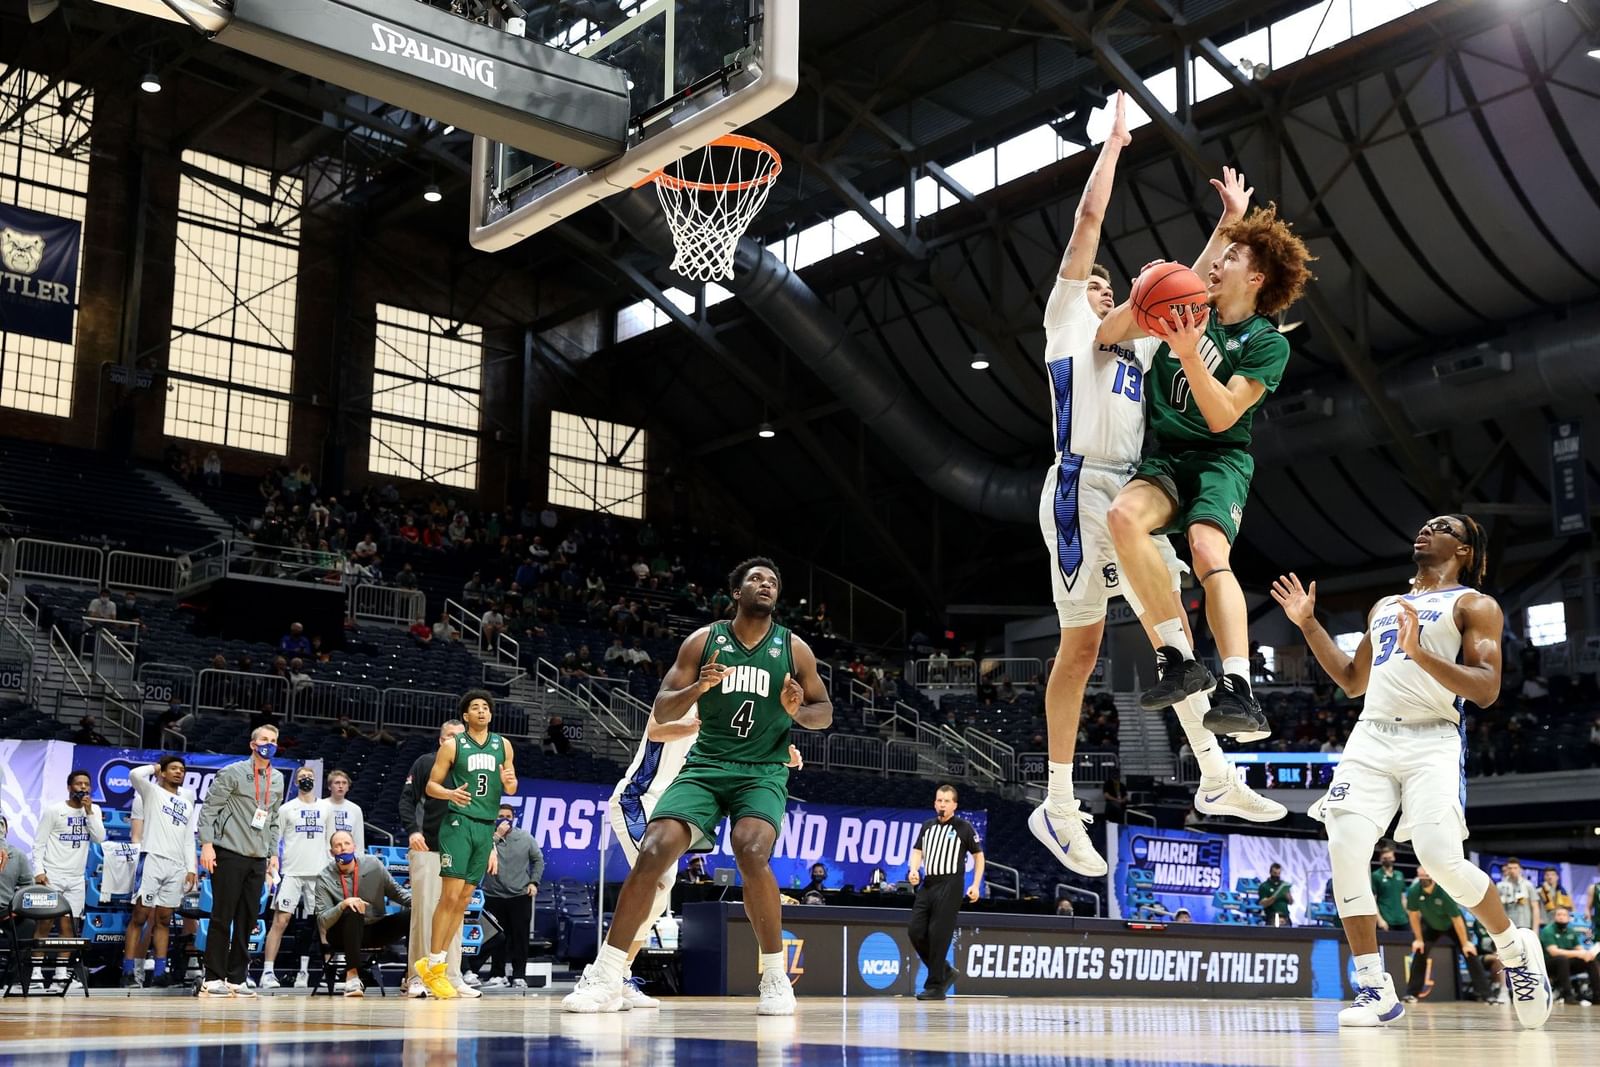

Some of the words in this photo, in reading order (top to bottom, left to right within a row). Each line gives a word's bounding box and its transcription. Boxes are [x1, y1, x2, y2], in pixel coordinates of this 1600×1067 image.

[371, 22, 494, 89] SPALDING
[1111, 360, 1143, 403] 13
[145, 684, 172, 701] 206
[721, 665, 771, 698] OHIO
[730, 699, 755, 738] 4
[562, 725, 583, 739] 206
[467, 753, 496, 773] OHIO
[1023, 760, 1045, 774] 208
[1278, 767, 1301, 783] BLK
[475, 773, 489, 797] 3
[1147, 840, 1199, 865] MARCH
[1154, 863, 1221, 889] MADNESS
[96, 934, 125, 943] POWER
[862, 958, 900, 975] NCAA
[966, 943, 1105, 980] CELEBRATES
[1108, 947, 1300, 984] STUDENT-ATHLETES
